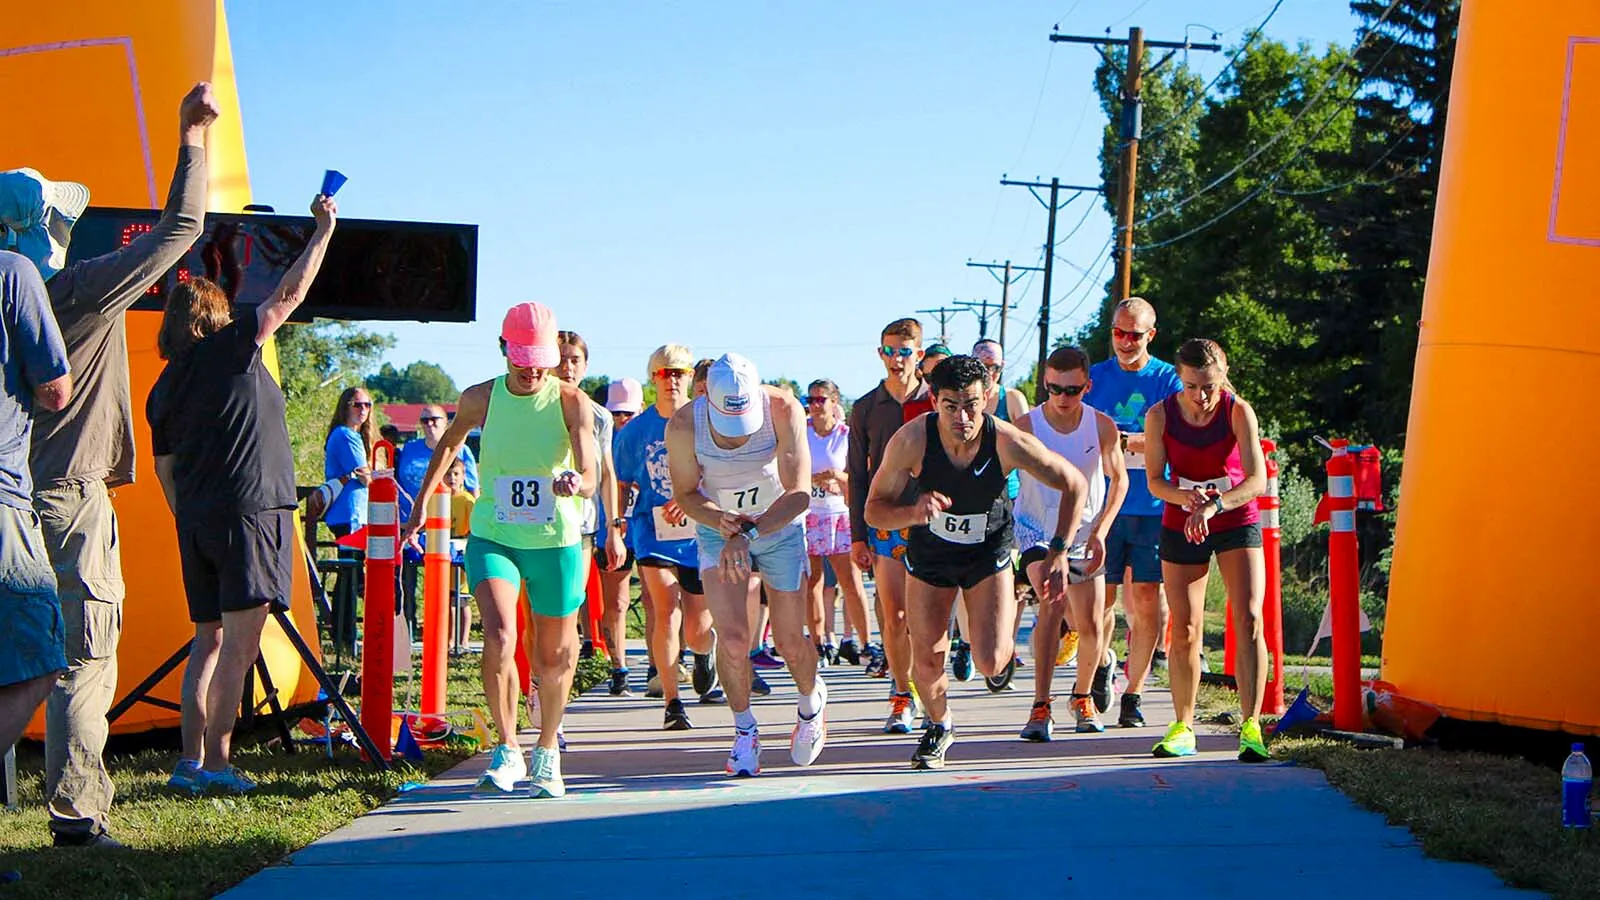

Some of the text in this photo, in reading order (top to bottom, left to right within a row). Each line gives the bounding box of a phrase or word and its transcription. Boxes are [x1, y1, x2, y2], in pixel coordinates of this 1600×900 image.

[511, 480, 540, 507] 83
[734, 487, 759, 508] 77
[945, 517, 972, 535] 64
